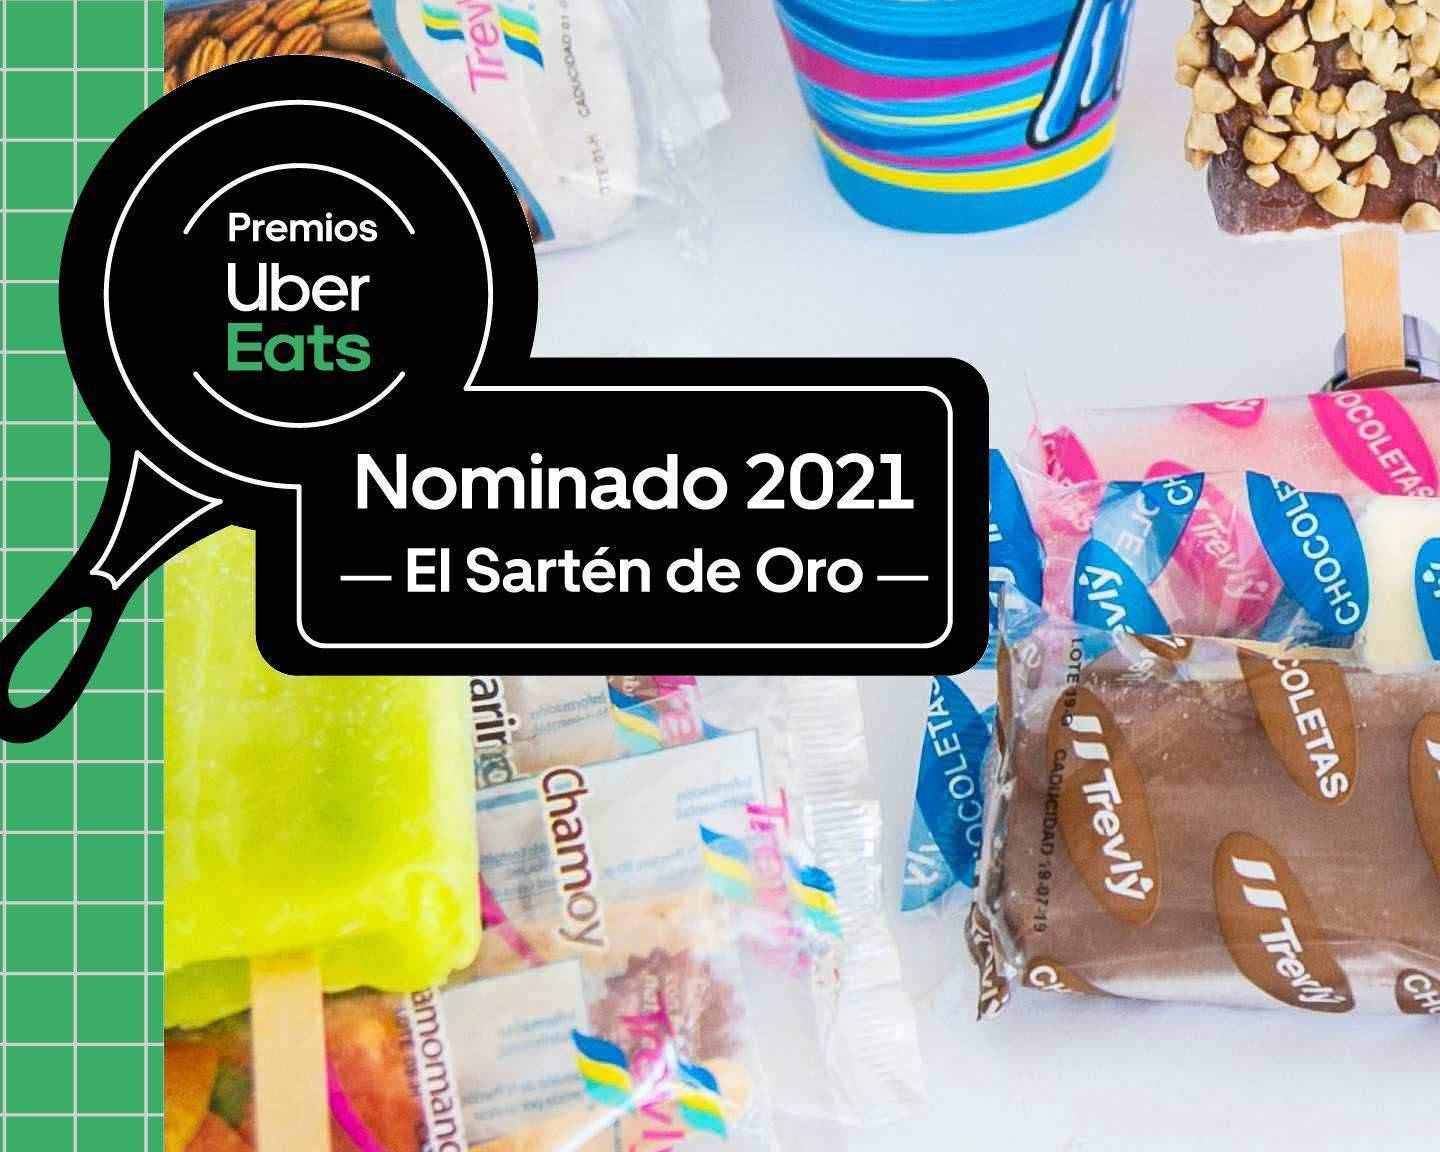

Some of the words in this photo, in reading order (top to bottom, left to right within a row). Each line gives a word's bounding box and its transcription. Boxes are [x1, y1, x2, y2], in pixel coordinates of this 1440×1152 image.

[1066, 638, 1083, 684] LOTE
[541, 767, 605, 948] Chamoy
[1042, 748, 1067, 857] CADUCIDAD
[1081, 767, 1153, 901] Trevly
